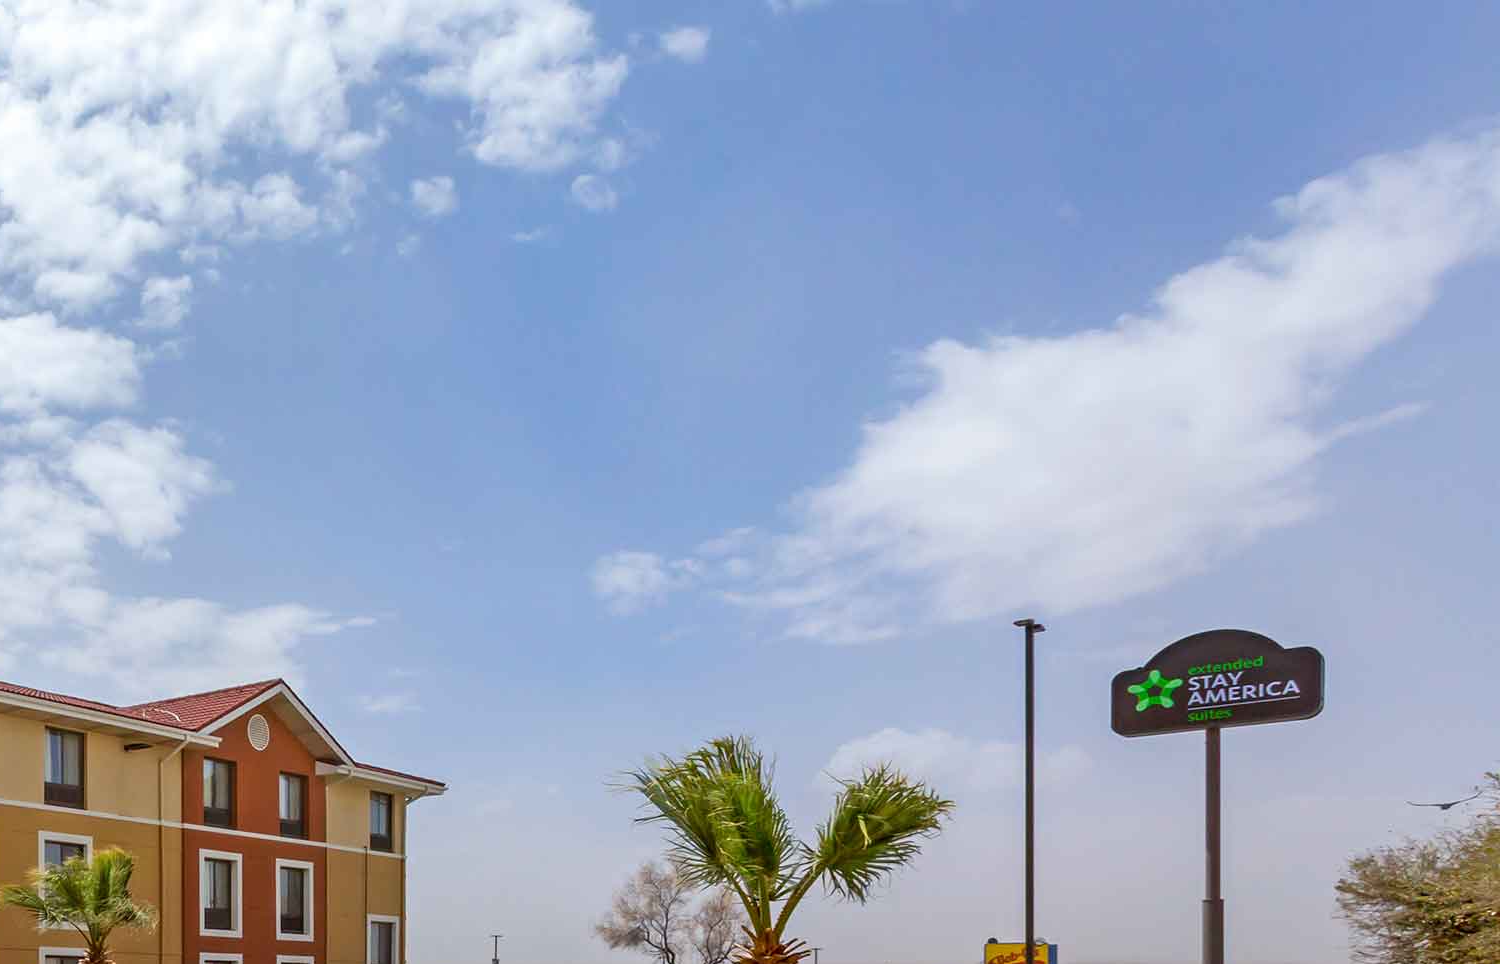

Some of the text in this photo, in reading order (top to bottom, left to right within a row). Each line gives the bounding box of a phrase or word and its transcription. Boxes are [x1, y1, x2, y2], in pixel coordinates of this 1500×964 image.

[1188, 656, 1263, 675] extended
[1188, 671, 1242, 691] STAY
[1188, 680, 1300, 706] AMERICA
[1188, 708, 1232, 722] suites
